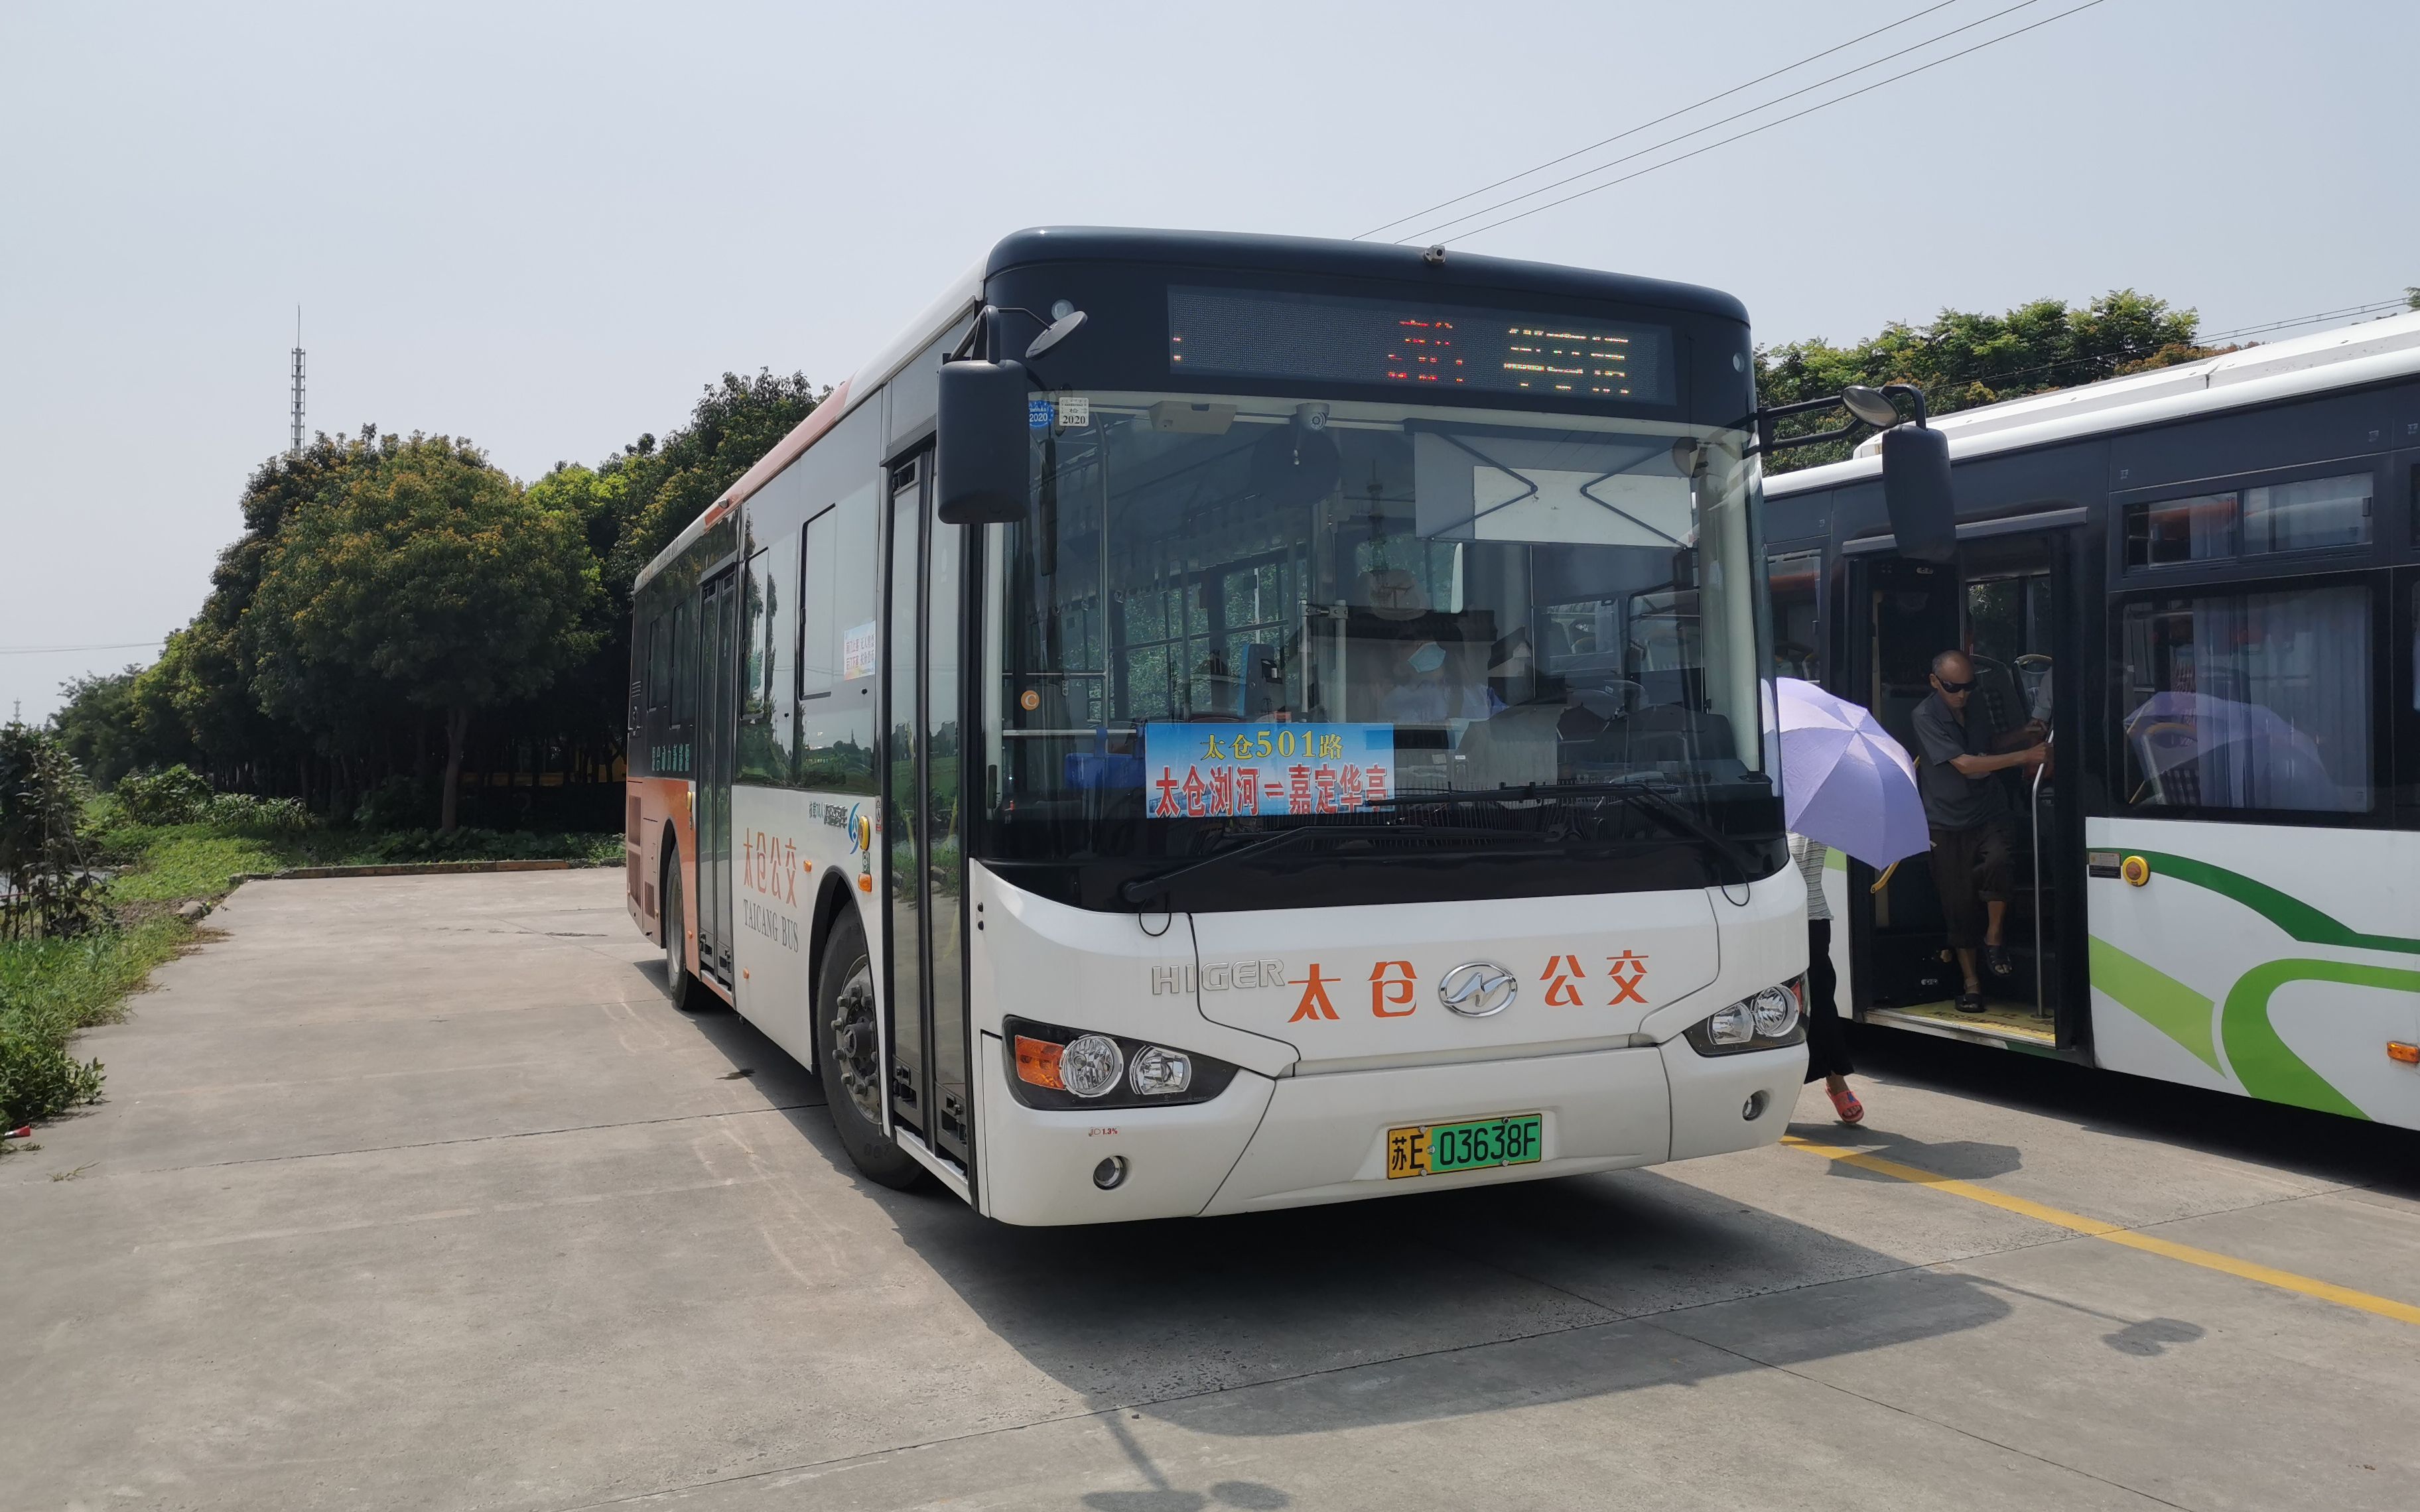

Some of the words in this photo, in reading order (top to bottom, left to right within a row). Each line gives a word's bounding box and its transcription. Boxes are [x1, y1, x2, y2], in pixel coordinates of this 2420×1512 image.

[1030, 412, 1048, 422] 2020
[1063, 415, 1086, 424] 2020
[1200, 729, 1344, 761] 太仓501路
[1154, 764, 1260, 818] 太仓浏河
[1288, 763, 1388, 815] 嘉定华亭
[743, 827, 797, 909] 太仓公交
[743, 899, 778, 942] TAICANG
[781, 915, 799, 954] BUS
[1152, 958, 1286, 995] HIGER
[1287, 960, 1418, 1023] 太仓
[1539, 949, 1649, 1007] 公交
[1391, 1134, 1425, 1171] 苏E
[1440, 1121, 1538, 1166] 03638F
